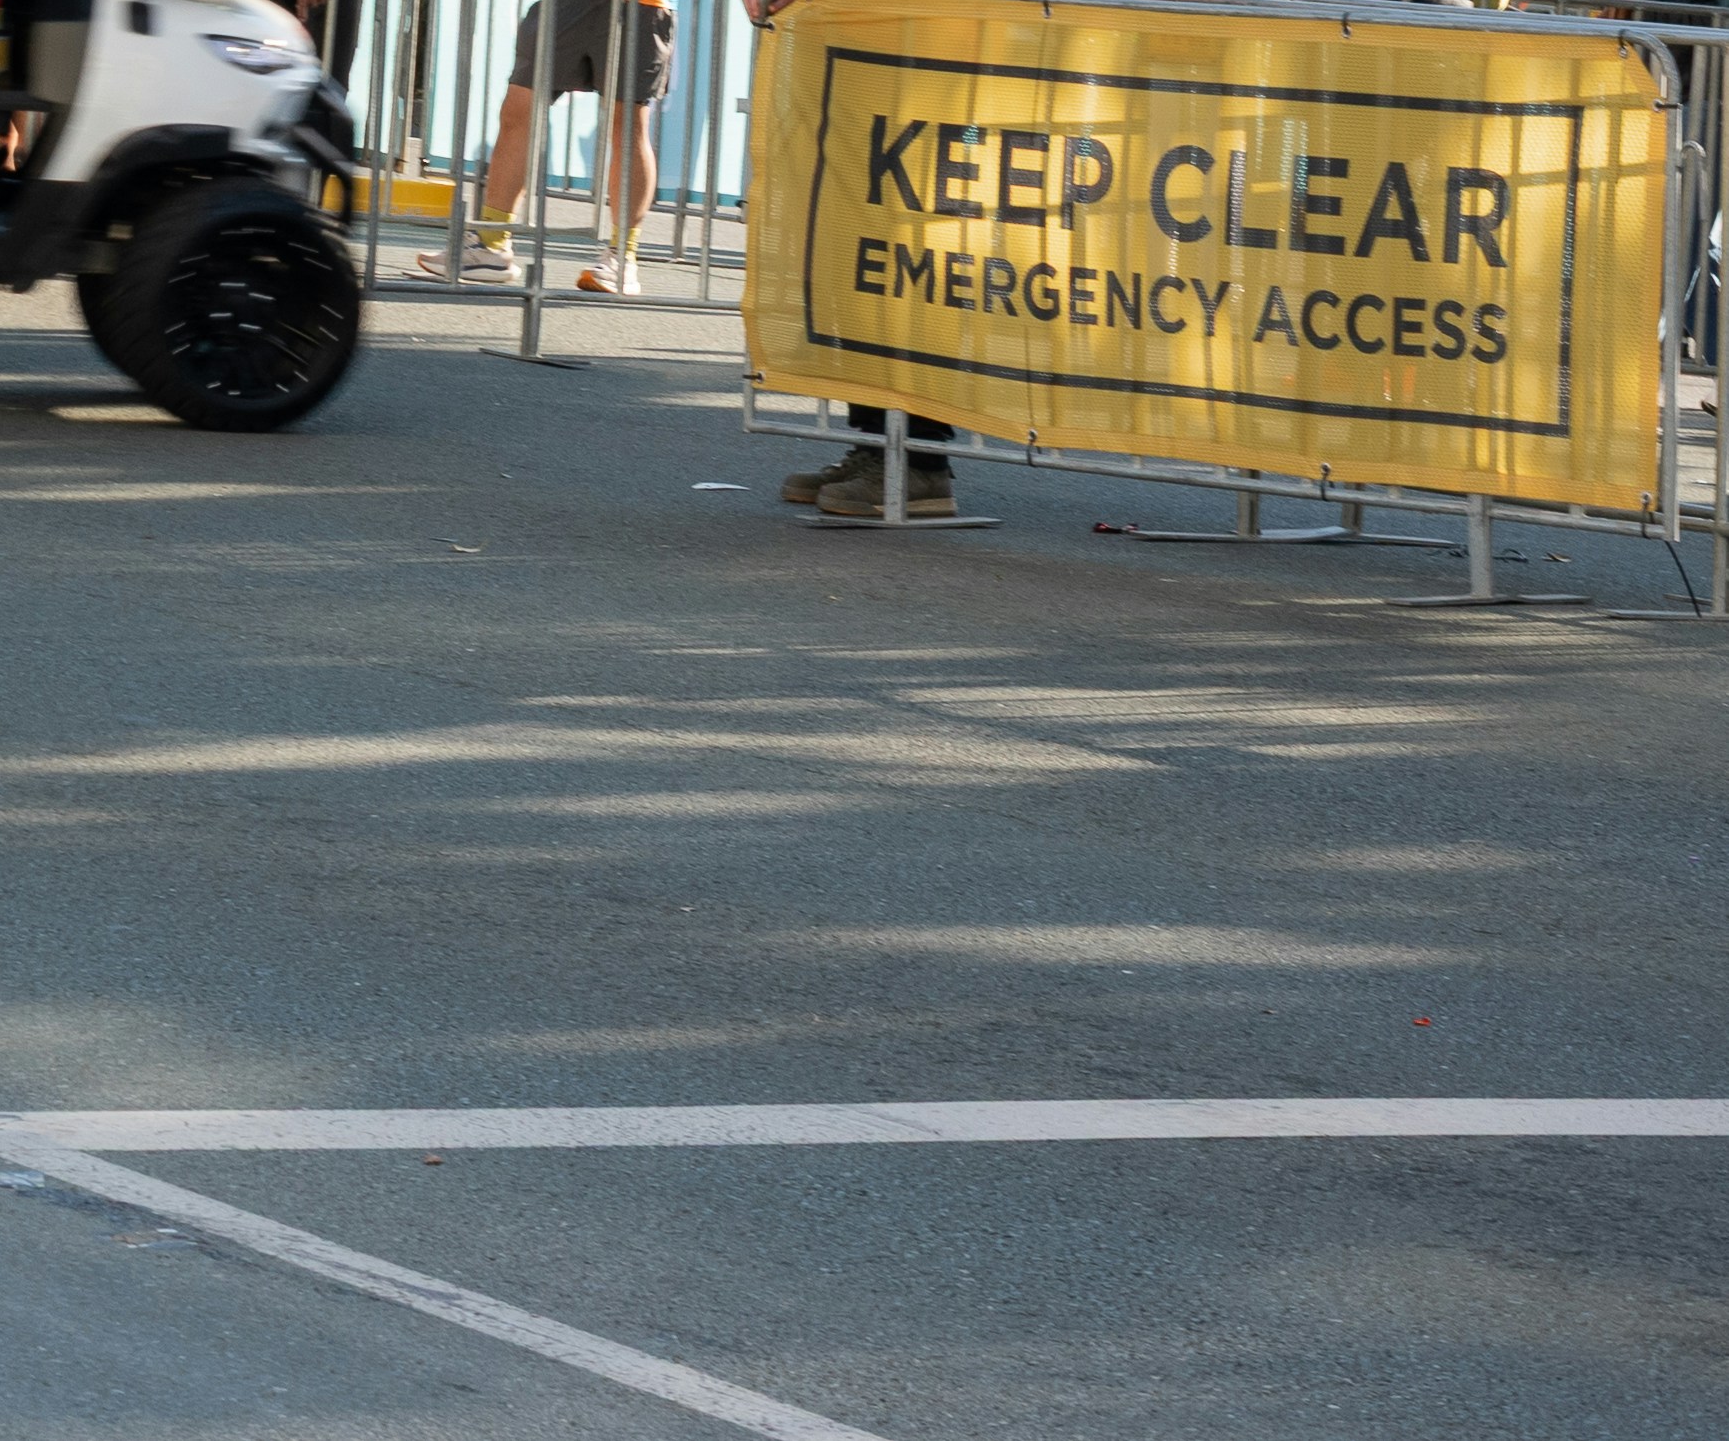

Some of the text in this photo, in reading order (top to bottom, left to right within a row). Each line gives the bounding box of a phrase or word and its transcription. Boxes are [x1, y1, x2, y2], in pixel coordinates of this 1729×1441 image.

[866, 114, 1512, 268] KEEP CLEAR
[853, 237, 1510, 366] EMERGENCY ACCESS
